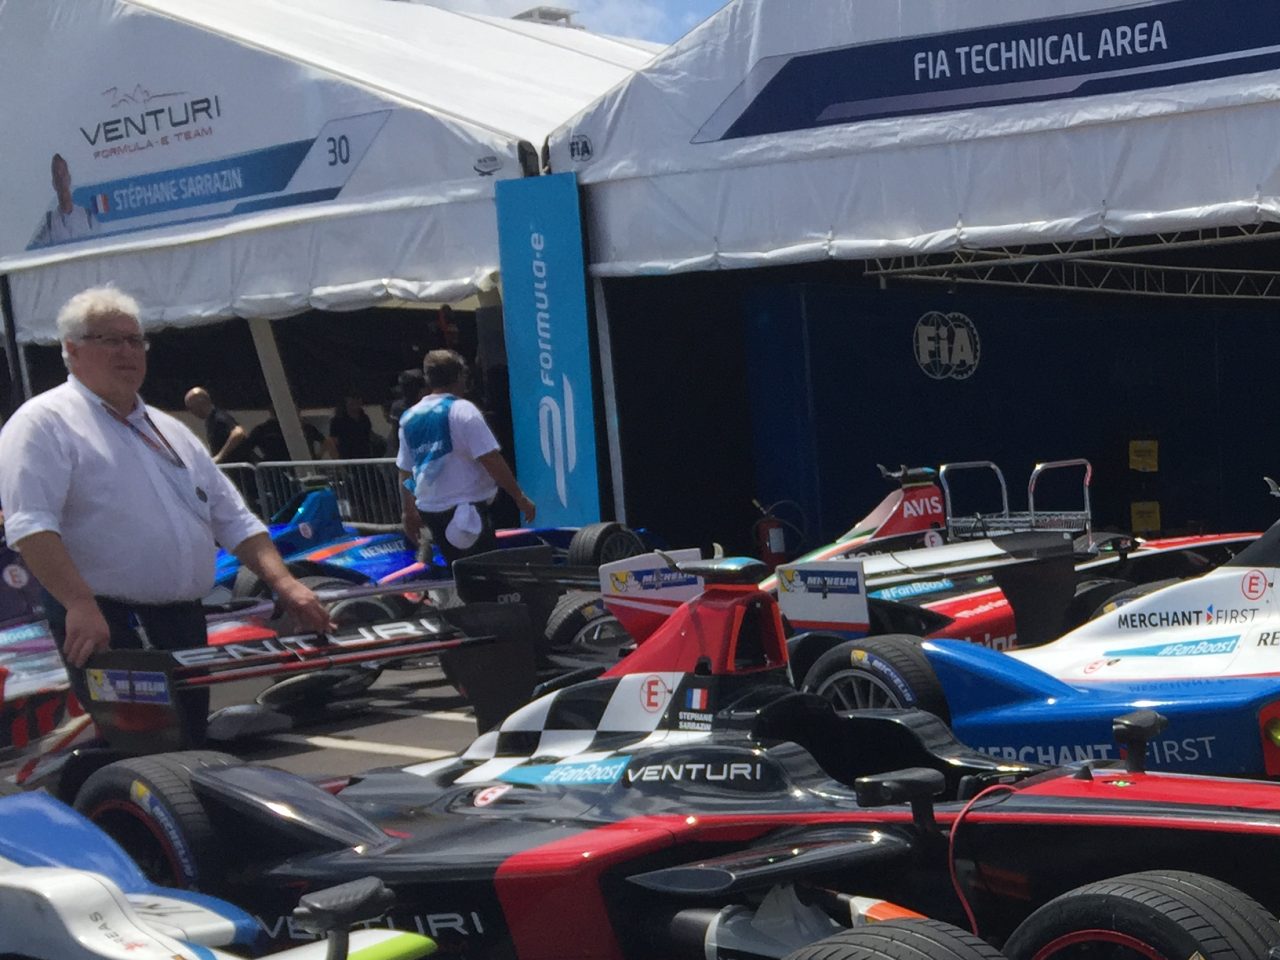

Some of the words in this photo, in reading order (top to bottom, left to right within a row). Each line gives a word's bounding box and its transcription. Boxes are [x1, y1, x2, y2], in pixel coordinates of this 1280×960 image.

[913, 50, 951, 81] FIA
[955, 31, 1091, 76] TECHNICAL
[1097, 20, 1168, 59] AREA
[79, 95, 221, 146] VENTURI
[174, 126, 213, 143] TEAM
[326, 134, 350, 167] 30
[570, 138, 592, 157] FIA
[179, 167, 244, 199] SARRAZIN
[918, 326, 976, 366] FIA
[903, 496, 943, 519] AVIS
[1118, 610, 1203, 629] MERCHANT
[1215, 608, 1259, 624] FIRST
[1158, 639, 1236, 656] #FanBoost
[679, 711, 713, 722] STEPHANE
[628, 763, 761, 782] VENTURI
